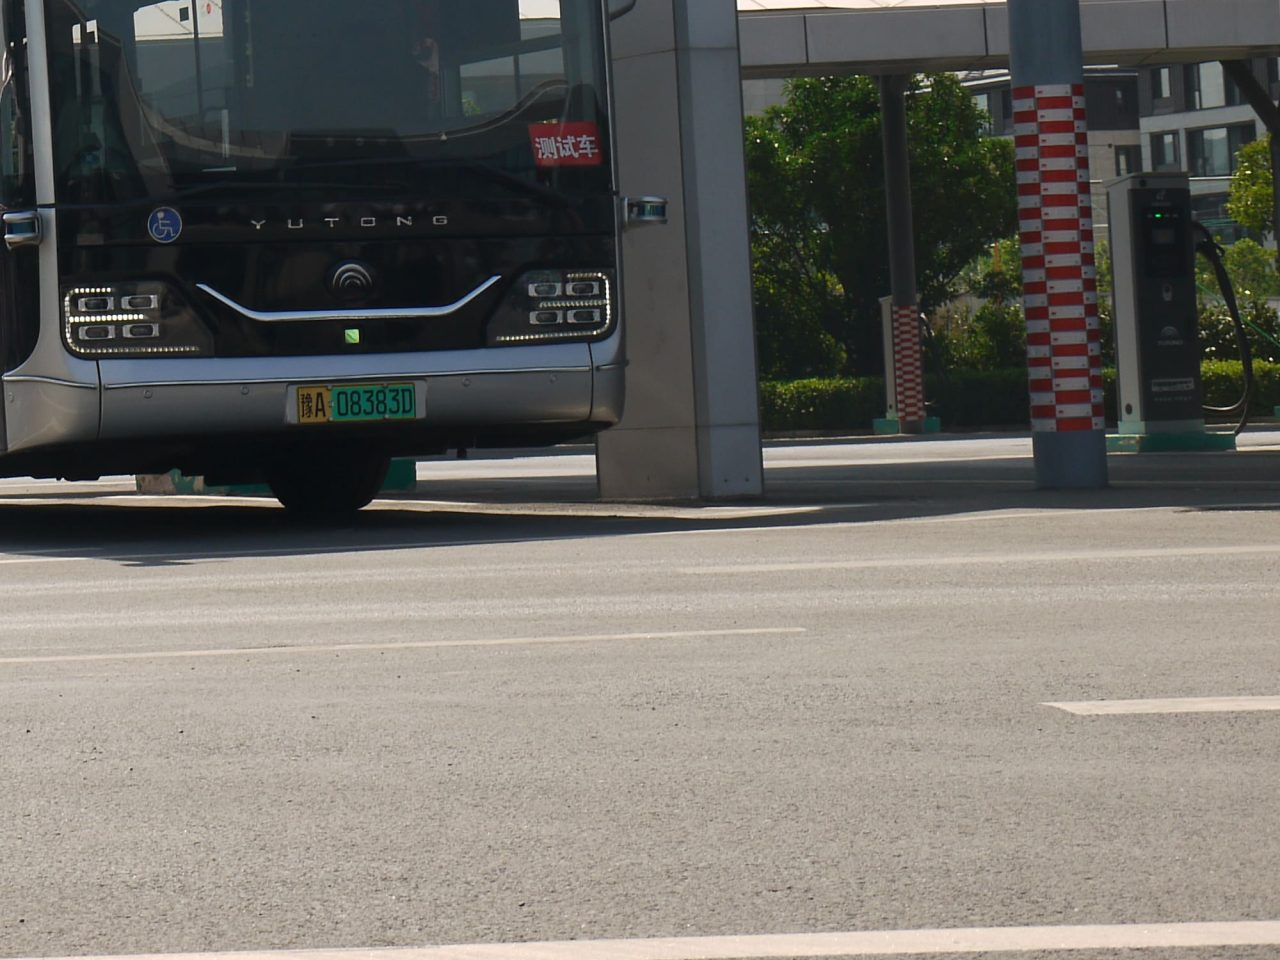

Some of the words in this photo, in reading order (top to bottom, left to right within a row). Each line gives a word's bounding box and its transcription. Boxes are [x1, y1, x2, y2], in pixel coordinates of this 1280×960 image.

[535, 135, 598, 159] 测试车
[250, 215, 448, 230] YUTONG
